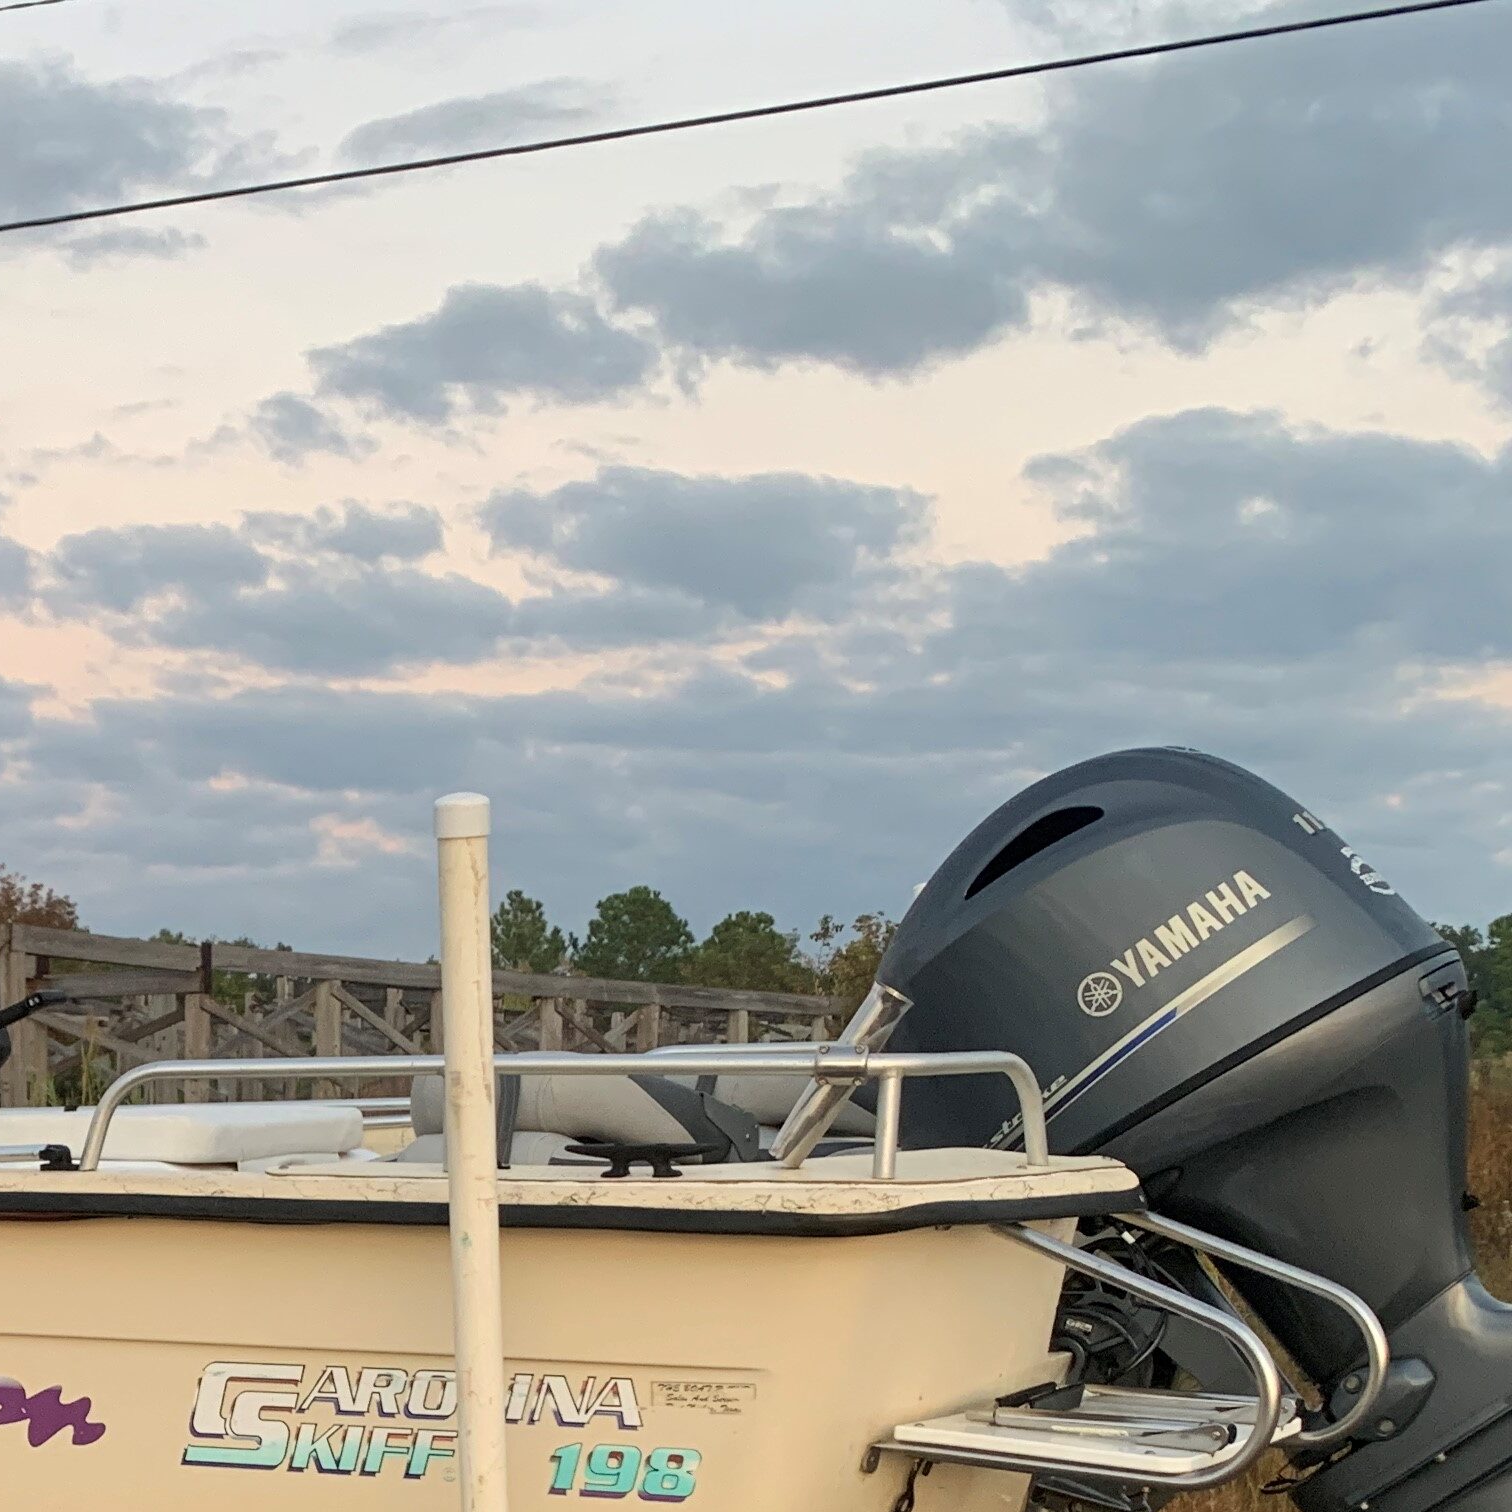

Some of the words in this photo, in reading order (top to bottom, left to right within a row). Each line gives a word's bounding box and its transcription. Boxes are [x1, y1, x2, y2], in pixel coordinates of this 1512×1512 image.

[1109, 870, 1272, 988] YAMAHA
[181, 1389, 459, 1480] SKIFF
[548, 1442, 702, 1503] 198
[188, 1361, 644, 1440] CAROINA
